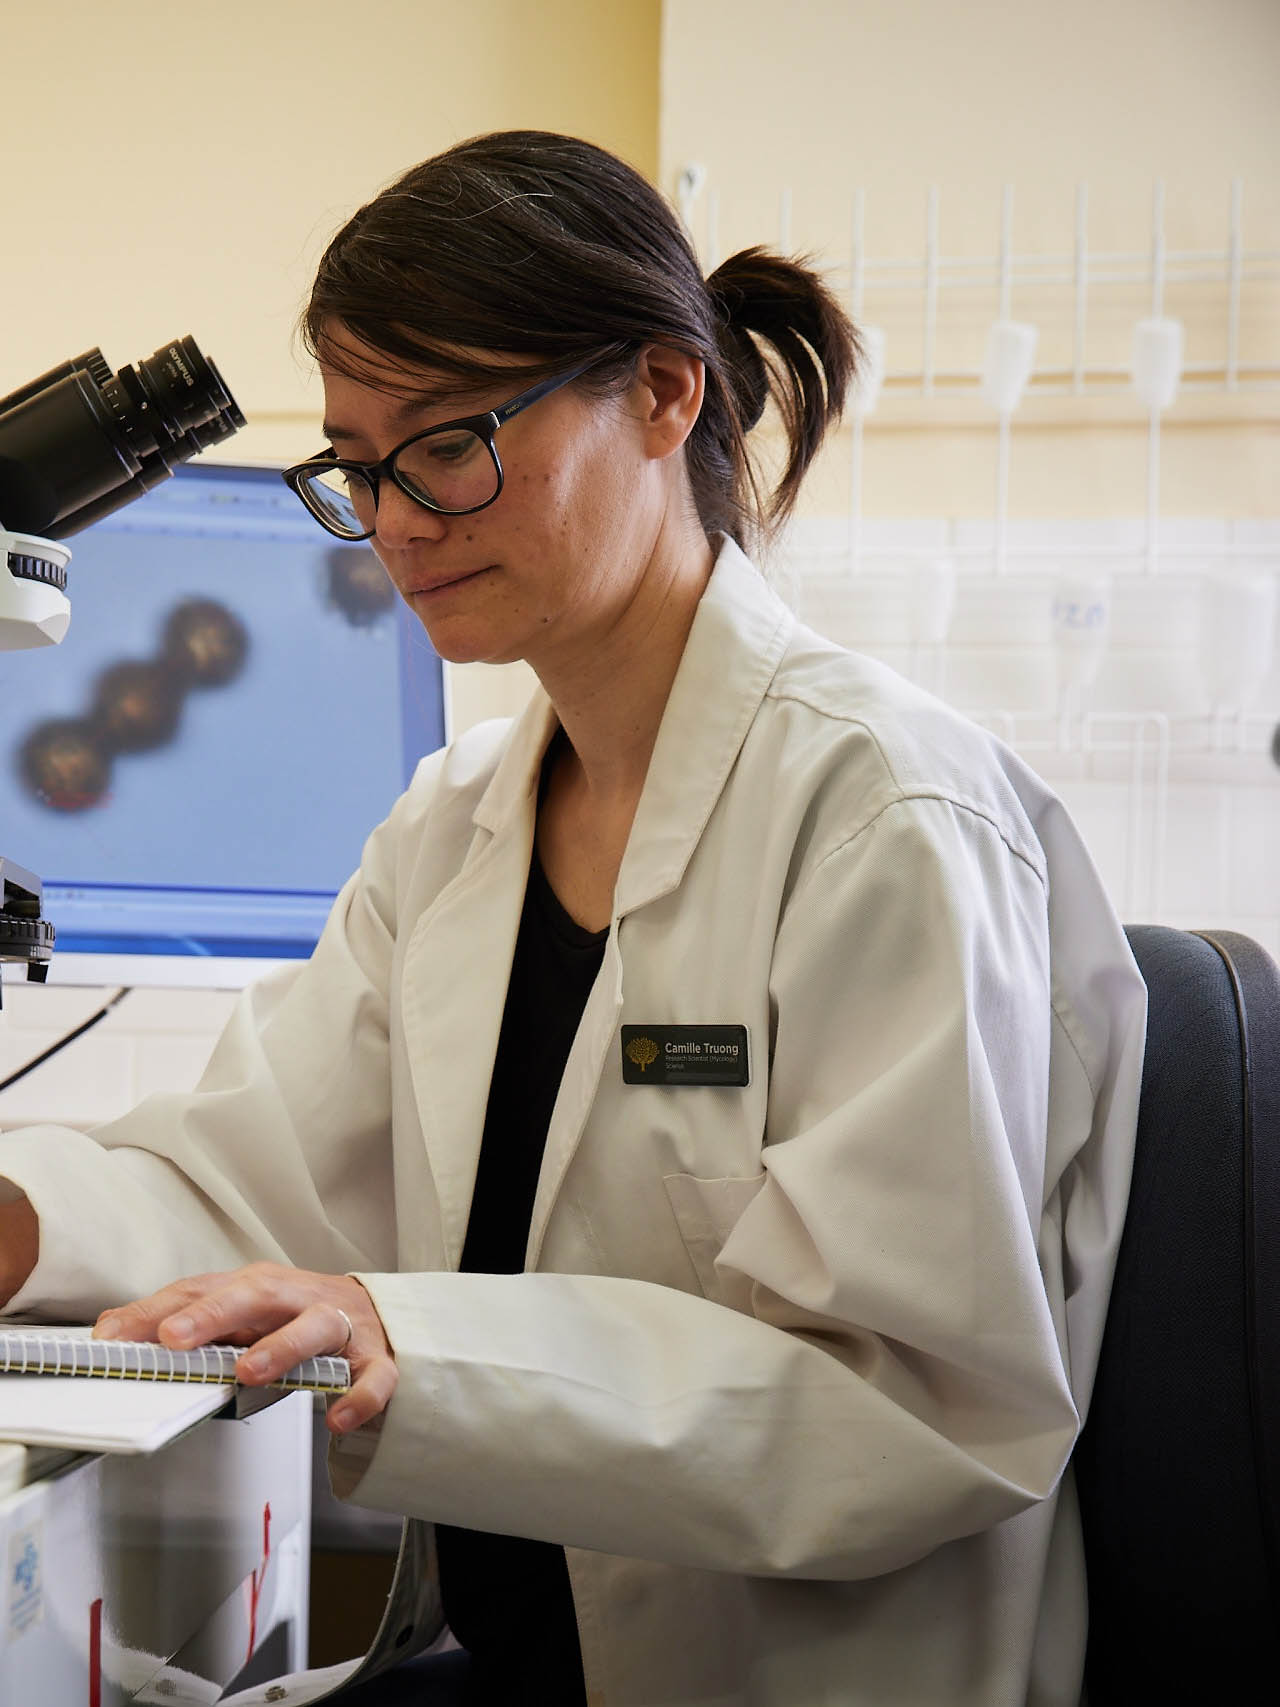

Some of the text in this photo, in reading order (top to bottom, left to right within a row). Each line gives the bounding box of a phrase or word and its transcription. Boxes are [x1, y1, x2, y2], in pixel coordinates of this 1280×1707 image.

[169, 347, 195, 387] OLYMPUS
[665, 1042, 739, 1056] Camille Truong
